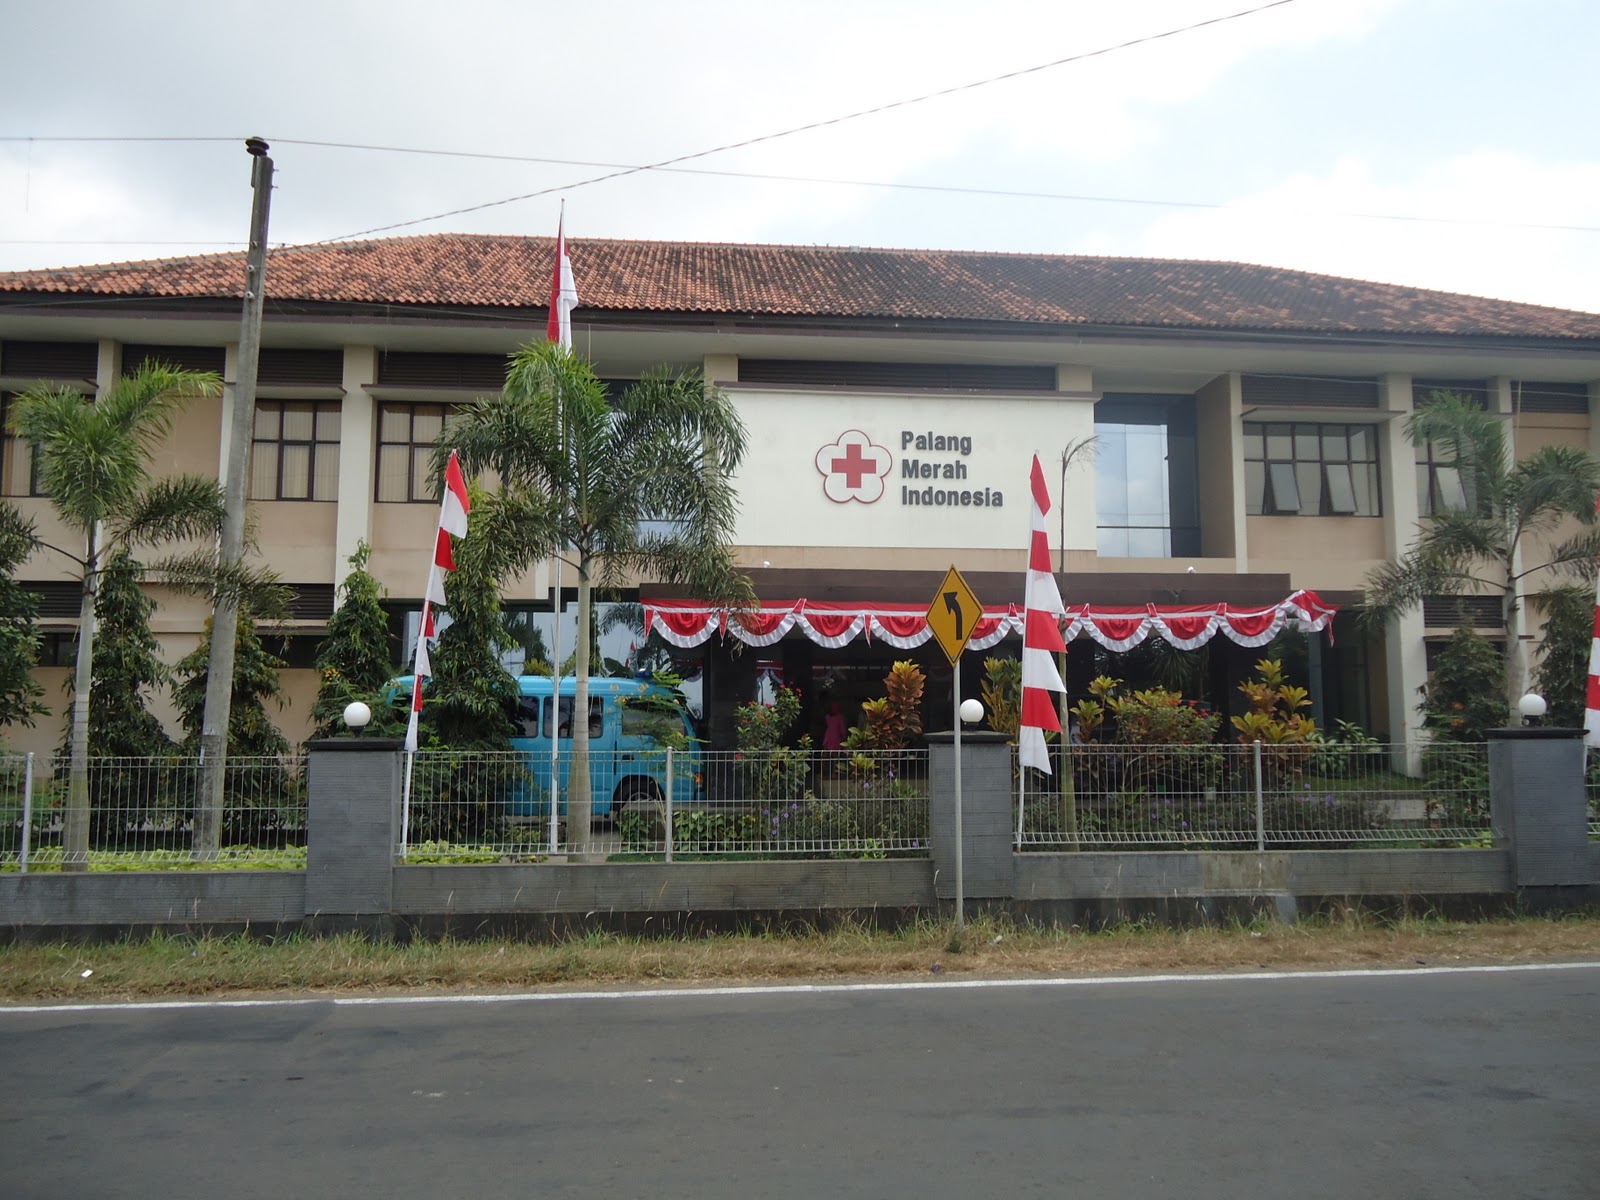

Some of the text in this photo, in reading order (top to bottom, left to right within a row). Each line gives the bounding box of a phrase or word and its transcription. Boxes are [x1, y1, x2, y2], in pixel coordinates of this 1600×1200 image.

[901, 431, 972, 456] Palang
[902, 459, 967, 480] Merah
[902, 485, 1003, 507] Indonesia
